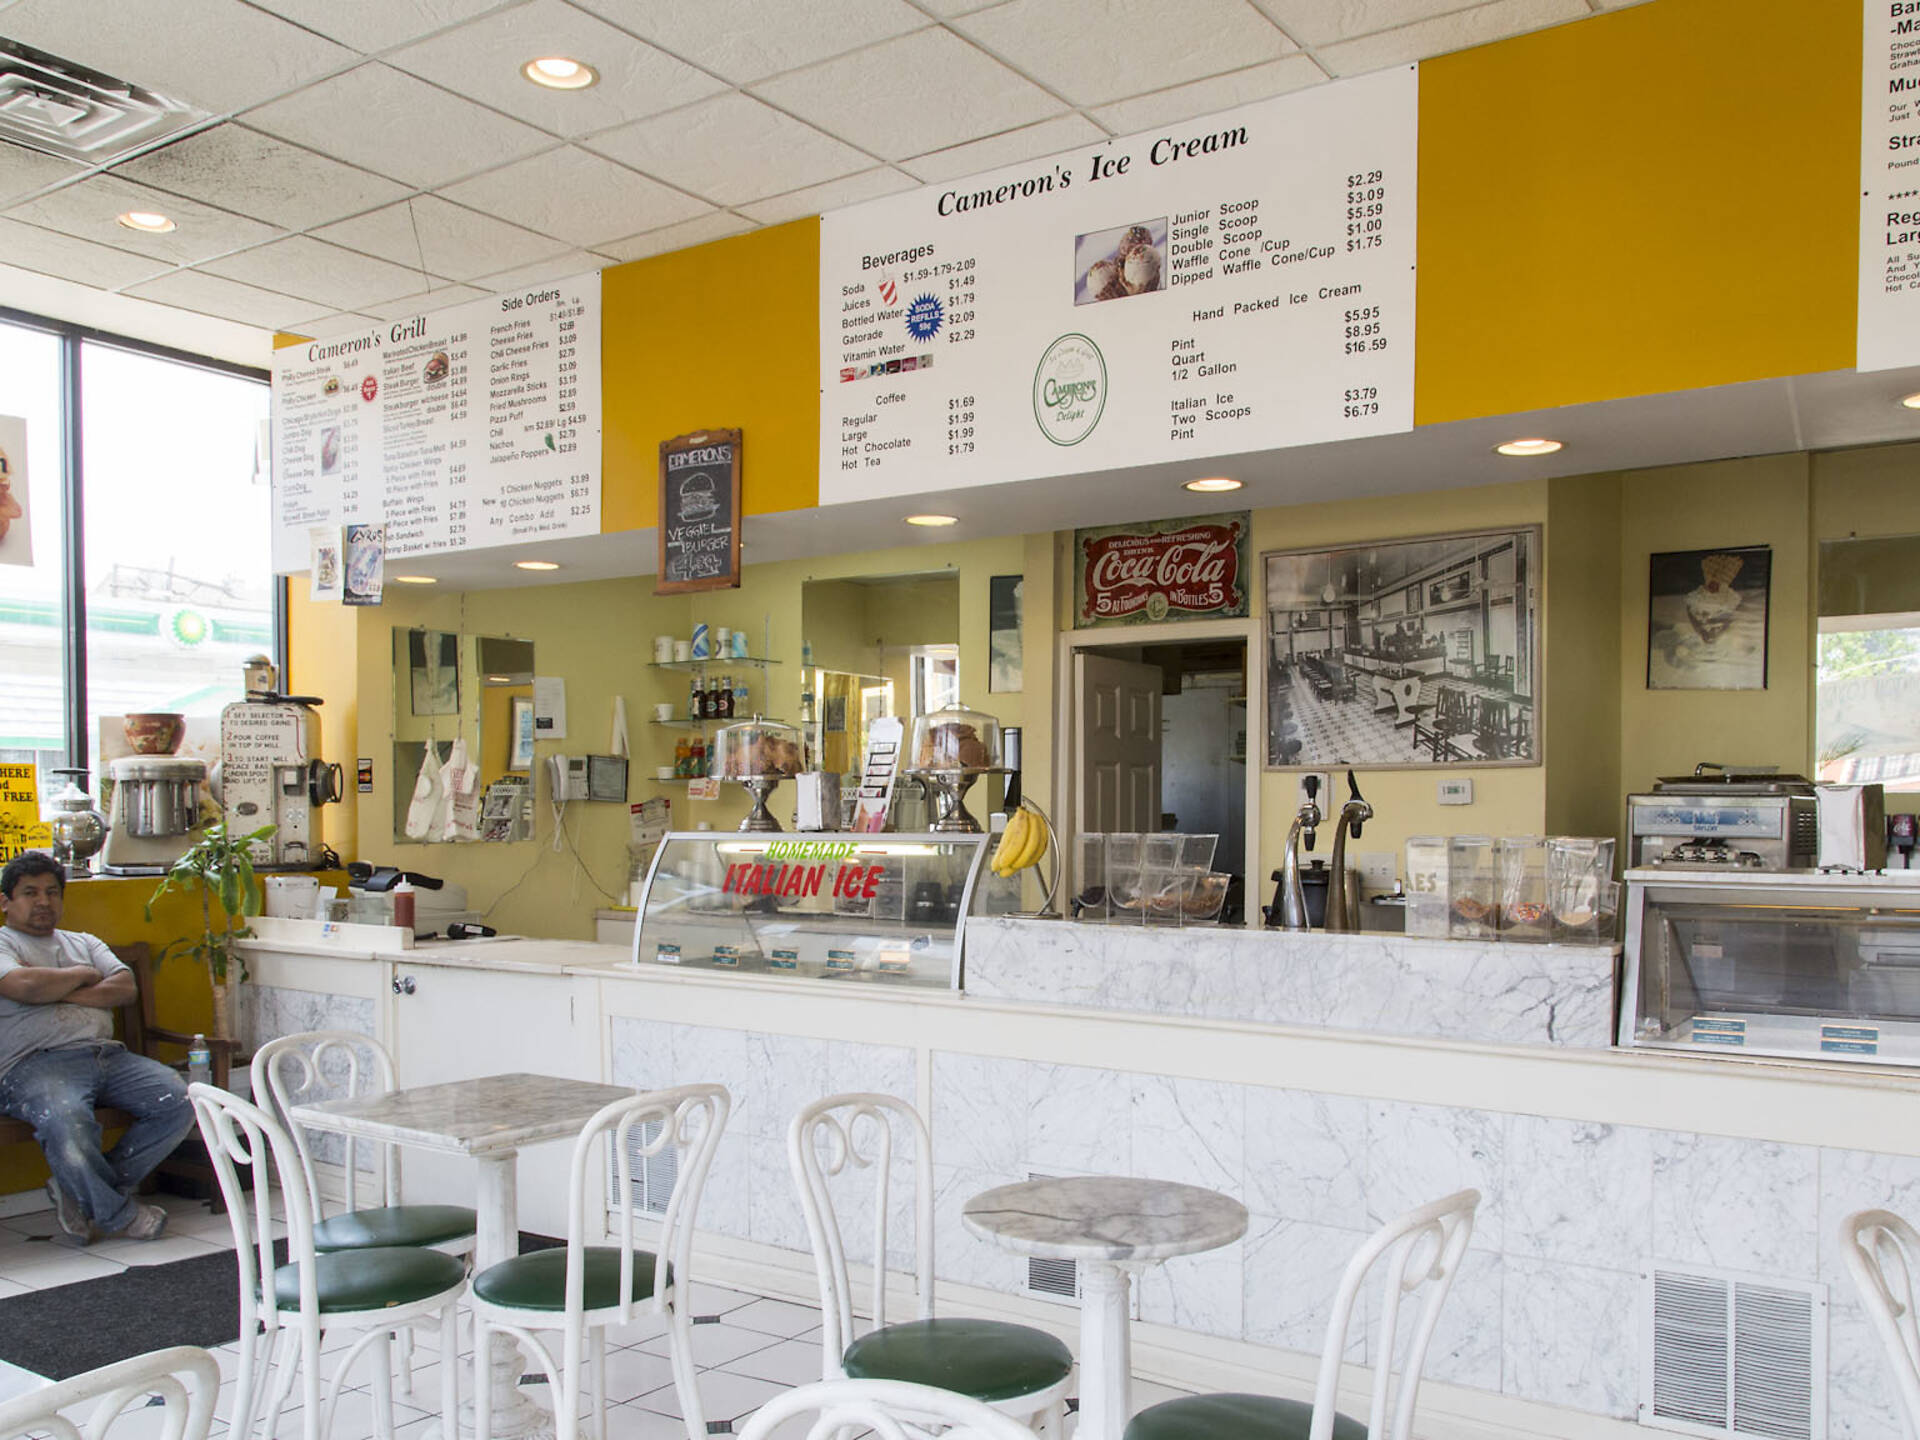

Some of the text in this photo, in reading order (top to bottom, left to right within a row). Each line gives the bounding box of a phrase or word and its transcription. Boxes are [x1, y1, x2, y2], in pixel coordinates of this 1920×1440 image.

[937, 126, 1248, 217] Cameron's Ice Cream
[1172, 170, 1383, 226] Junior Scoop $2.29
[1172, 187, 1384, 241] Single Scoop $3.09
[1171, 203, 1383, 256] Double Scoop $5.59
[1172, 219, 1382, 271] Waffle Cone /Cup $1.00
[862, 244, 934, 270] Beverages
[1171, 235, 1382, 286] Dipped Waffle Cone/Cup $1.75
[501, 289, 560, 312] Side Orders
[842, 283, 865, 296] Soda
[842, 275, 975, 312] Juices $1.49
[1193, 284, 1362, 322] Hand Packed Ice Cream
[514, 320, 531, 330] Fries
[842, 293, 975, 329] Bottled Water $1.79
[842, 311, 975, 345] Gatorade $2.09
[1172, 306, 1380, 351] Pint $5.95
[308, 329, 380, 362] Cameron's
[391, 317, 426, 343] Grill
[516, 332, 533, 342] Fries
[843, 329, 975, 363] Vitamin Water $2.29
[1172, 322, 1380, 367] Quart $8.95
[1172, 369, 1189, 381] 1/2
[1198, 362, 1237, 378] Gallon
[842, 396, 975, 427] Regular $1.69
[876, 393, 906, 406] Coffee
[1171, 393, 1234, 411] Italian Ice
[1172, 387, 1377, 425] Two Scoops $3.79
[842, 412, 975, 441] Large $1.99
[1170, 402, 1379, 440] Pint $6.79
[842, 427, 974, 456] Hot Chocolate $1.99
[842, 442, 975, 470] Hot Tea $1.79
[1093, 540, 1230, 590] Coca-Cola
[4, 792, 33, 802] FREE
[766, 841, 859, 861] HOMEMADE
[722, 863, 885, 899] ITALIAN ICE
